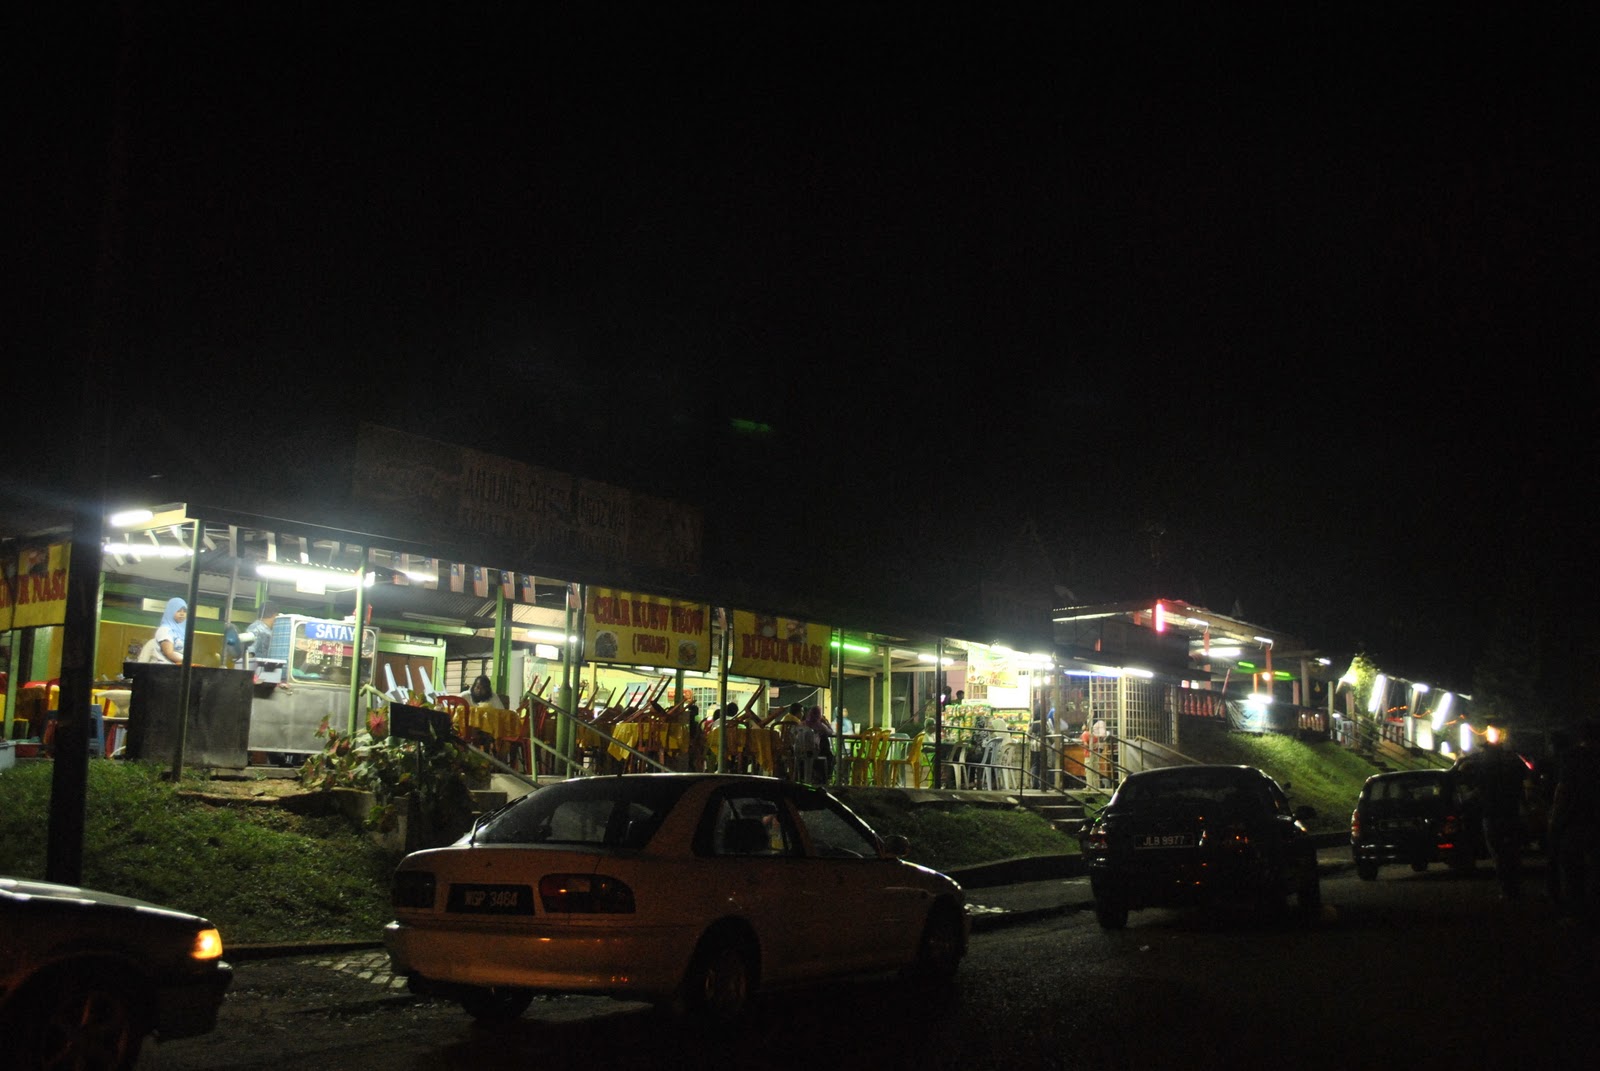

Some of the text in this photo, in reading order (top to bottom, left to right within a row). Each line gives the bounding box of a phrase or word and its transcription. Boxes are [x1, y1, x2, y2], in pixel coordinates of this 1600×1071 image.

[593, 595, 630, 627] CHAR
[315, 623, 356, 641] SATAY
[792, 641, 823, 668] NASI
